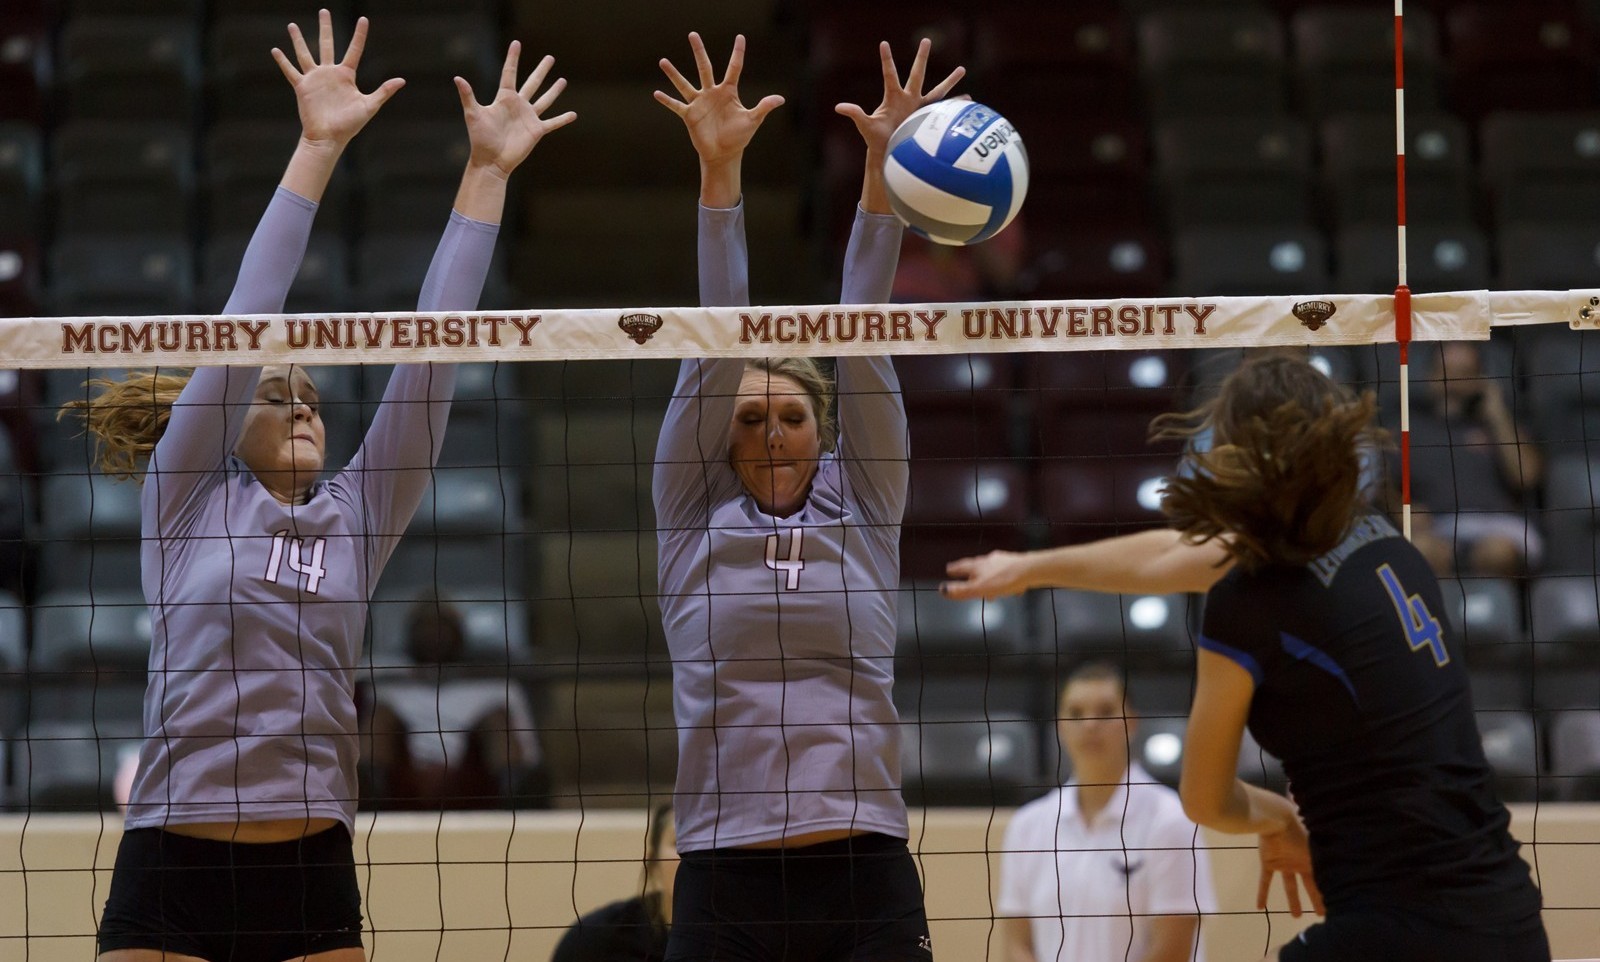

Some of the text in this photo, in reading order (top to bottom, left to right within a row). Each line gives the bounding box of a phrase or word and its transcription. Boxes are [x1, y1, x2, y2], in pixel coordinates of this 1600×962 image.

[285, 315, 541, 349] UNIVERSITY
[961, 304, 1216, 339] UNIVERSITY
[264, 529, 327, 595] 14
[764, 527, 805, 591] 4
[1375, 562, 1450, 668] 4
